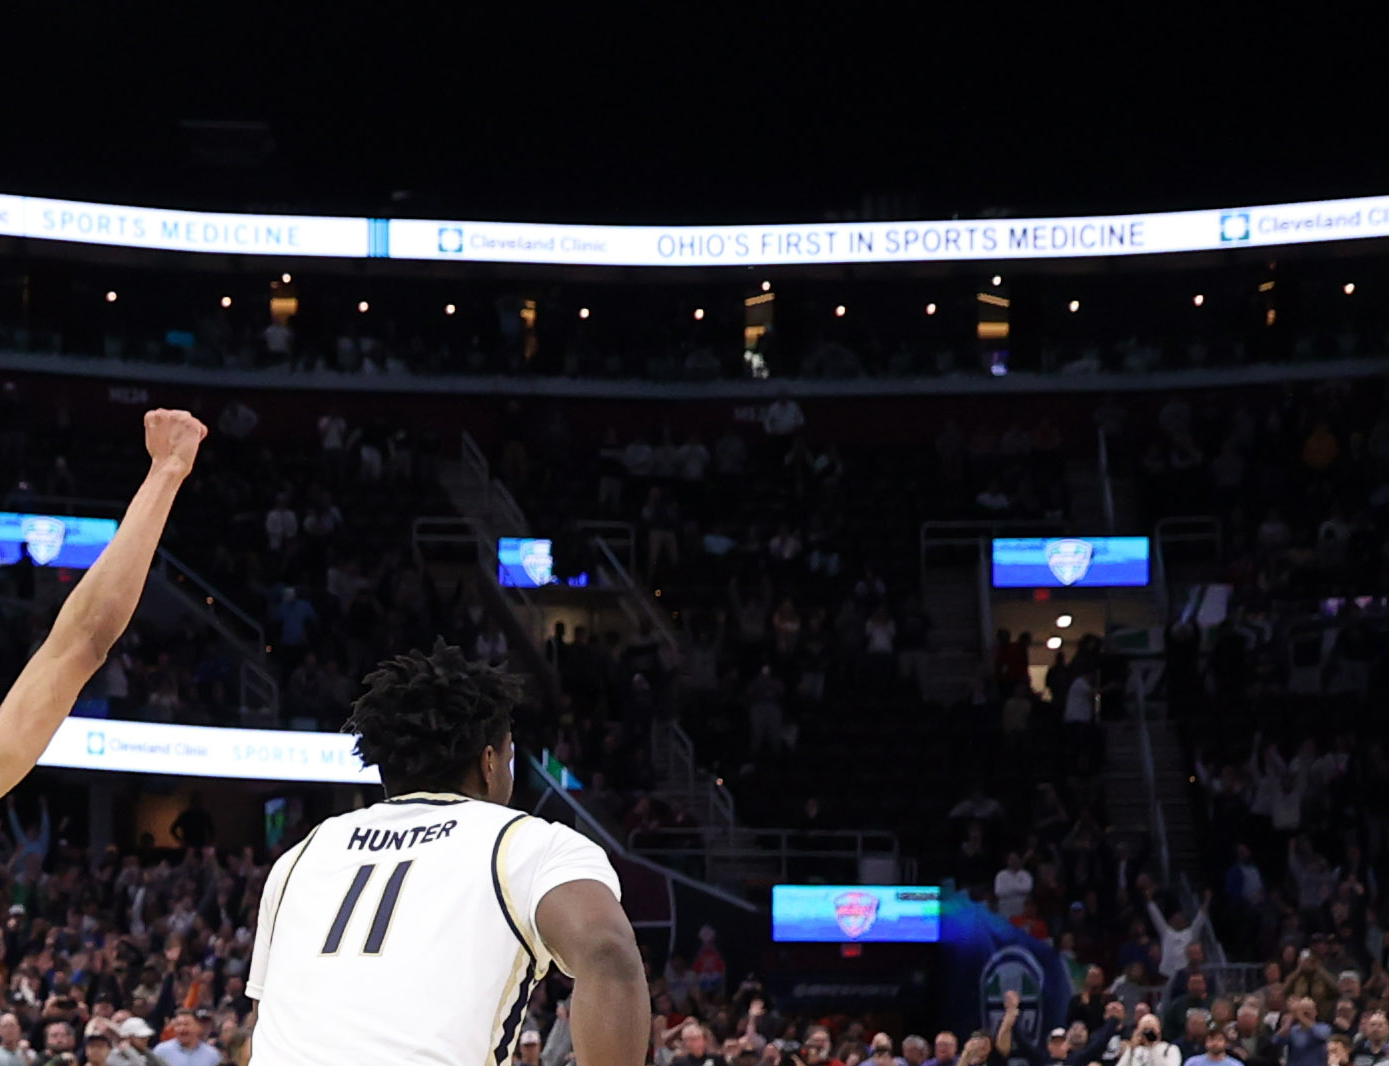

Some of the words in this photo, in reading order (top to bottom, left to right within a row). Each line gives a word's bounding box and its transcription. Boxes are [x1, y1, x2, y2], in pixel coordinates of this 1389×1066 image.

[42, 209, 146, 239] SPORTS
[161, 220, 302, 247] MEDICINE
[1258, 208, 1361, 233] Cleveland
[470, 234, 555, 252] Cleveland
[560, 237, 608, 253] Clinic
[657, 233, 750, 258] OHIO'S
[760, 231, 837, 256] FIRST
[849, 231, 874, 254] IN
[885, 227, 997, 254] SPORTS
[1009, 221, 1145, 250] MEDICINE
[234, 745, 309, 764] SPORTS
[347, 820, 458, 851] HUNTER
[318, 858, 416, 956] 11
